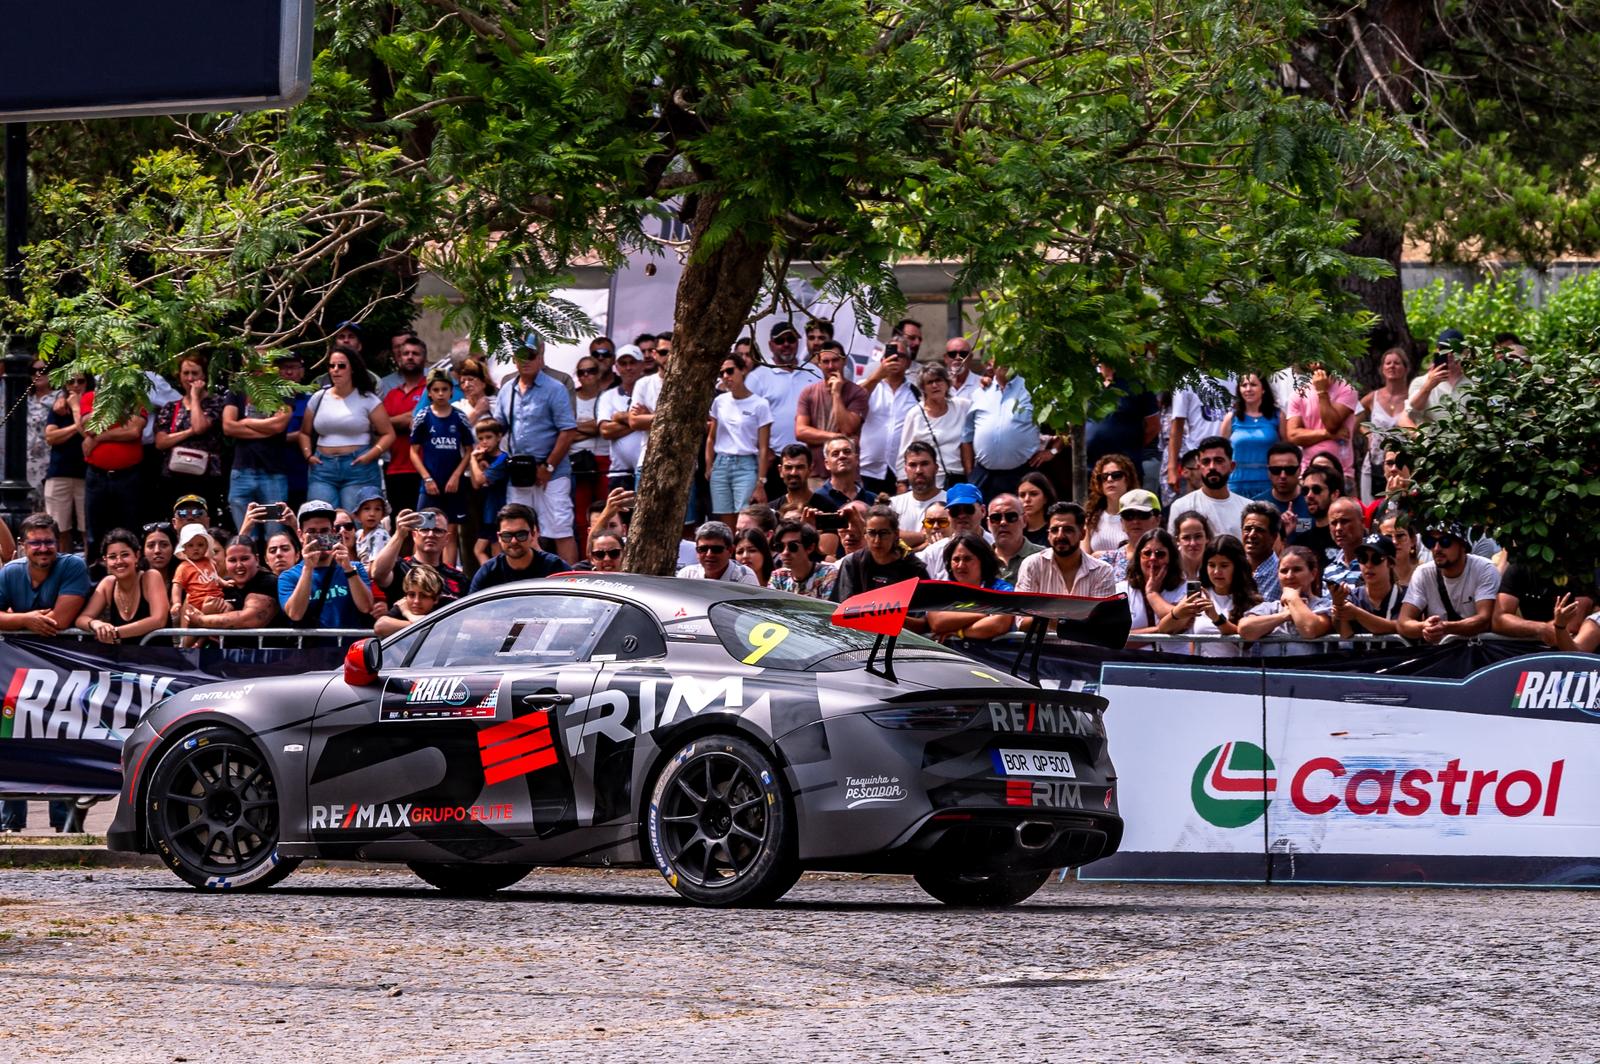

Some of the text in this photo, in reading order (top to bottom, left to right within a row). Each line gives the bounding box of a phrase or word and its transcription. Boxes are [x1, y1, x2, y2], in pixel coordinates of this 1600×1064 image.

[741, 622, 790, 665] 9
[12, 668, 176, 740] RALLY
[411, 677, 464, 701] RALLY
[1518, 671, 1600, 709] RALLY
[988, 702, 1088, 736] RE/MAX
[1004, 754, 1070, 773] BOR QP 500
[845, 785, 901, 799] PESCADOR
[846, 775, 889, 787] Tasquinha
[1290, 757, 1565, 818] Castrol
[311, 803, 513, 829] RE/MAX GRUPO ELITE
[650, 809, 666, 868] MICHELIN
